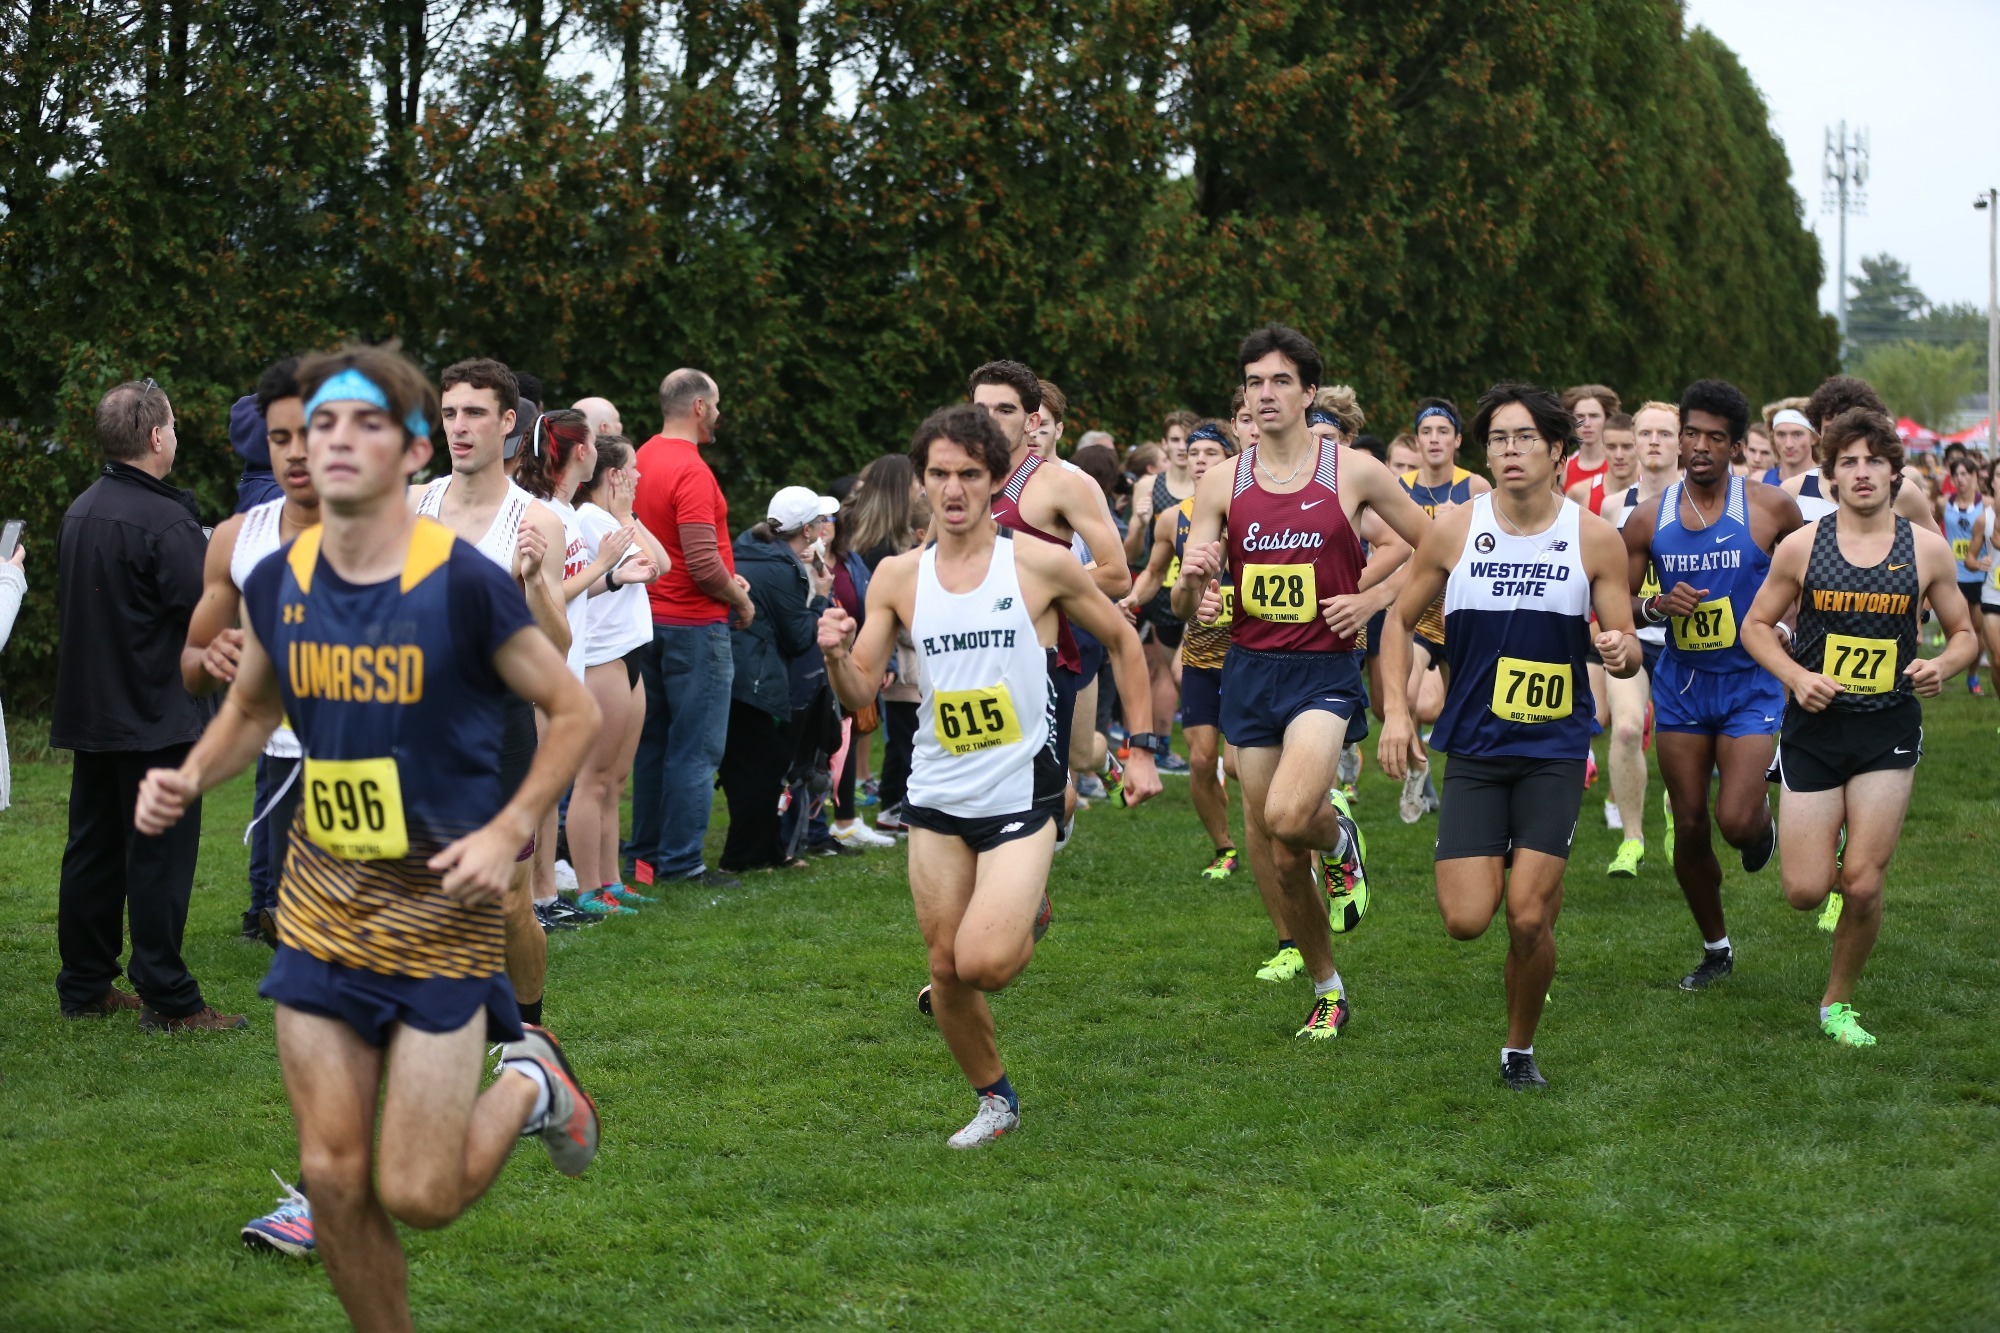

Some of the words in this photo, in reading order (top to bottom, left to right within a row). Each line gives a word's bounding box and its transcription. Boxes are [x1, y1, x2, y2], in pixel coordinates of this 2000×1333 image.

[1243, 522, 1323, 551] Eastern
[1470, 562, 1570, 581] WESTFIELD
[1661, 550, 1741, 572] WHEATON
[1252, 575, 1304, 608] 428
[1492, 581, 1547, 597] STATE
[1813, 590, 1911, 615] WENTWORTH
[1679, 608, 1723, 638] 787
[923, 629, 1016, 656] PLYMOUTH
[289, 641, 424, 704] UMASSD
[1833, 645, 1887, 679] 727
[1506, 670, 1564, 709] 760
[940, 698, 1004, 738] 615
[1511, 712, 1525, 720] 802
[1527, 714, 1553, 722] TIMING
[955, 743, 972, 753] 802
[973, 738, 1002, 750] TIMING
[312, 780, 385, 831] 696
